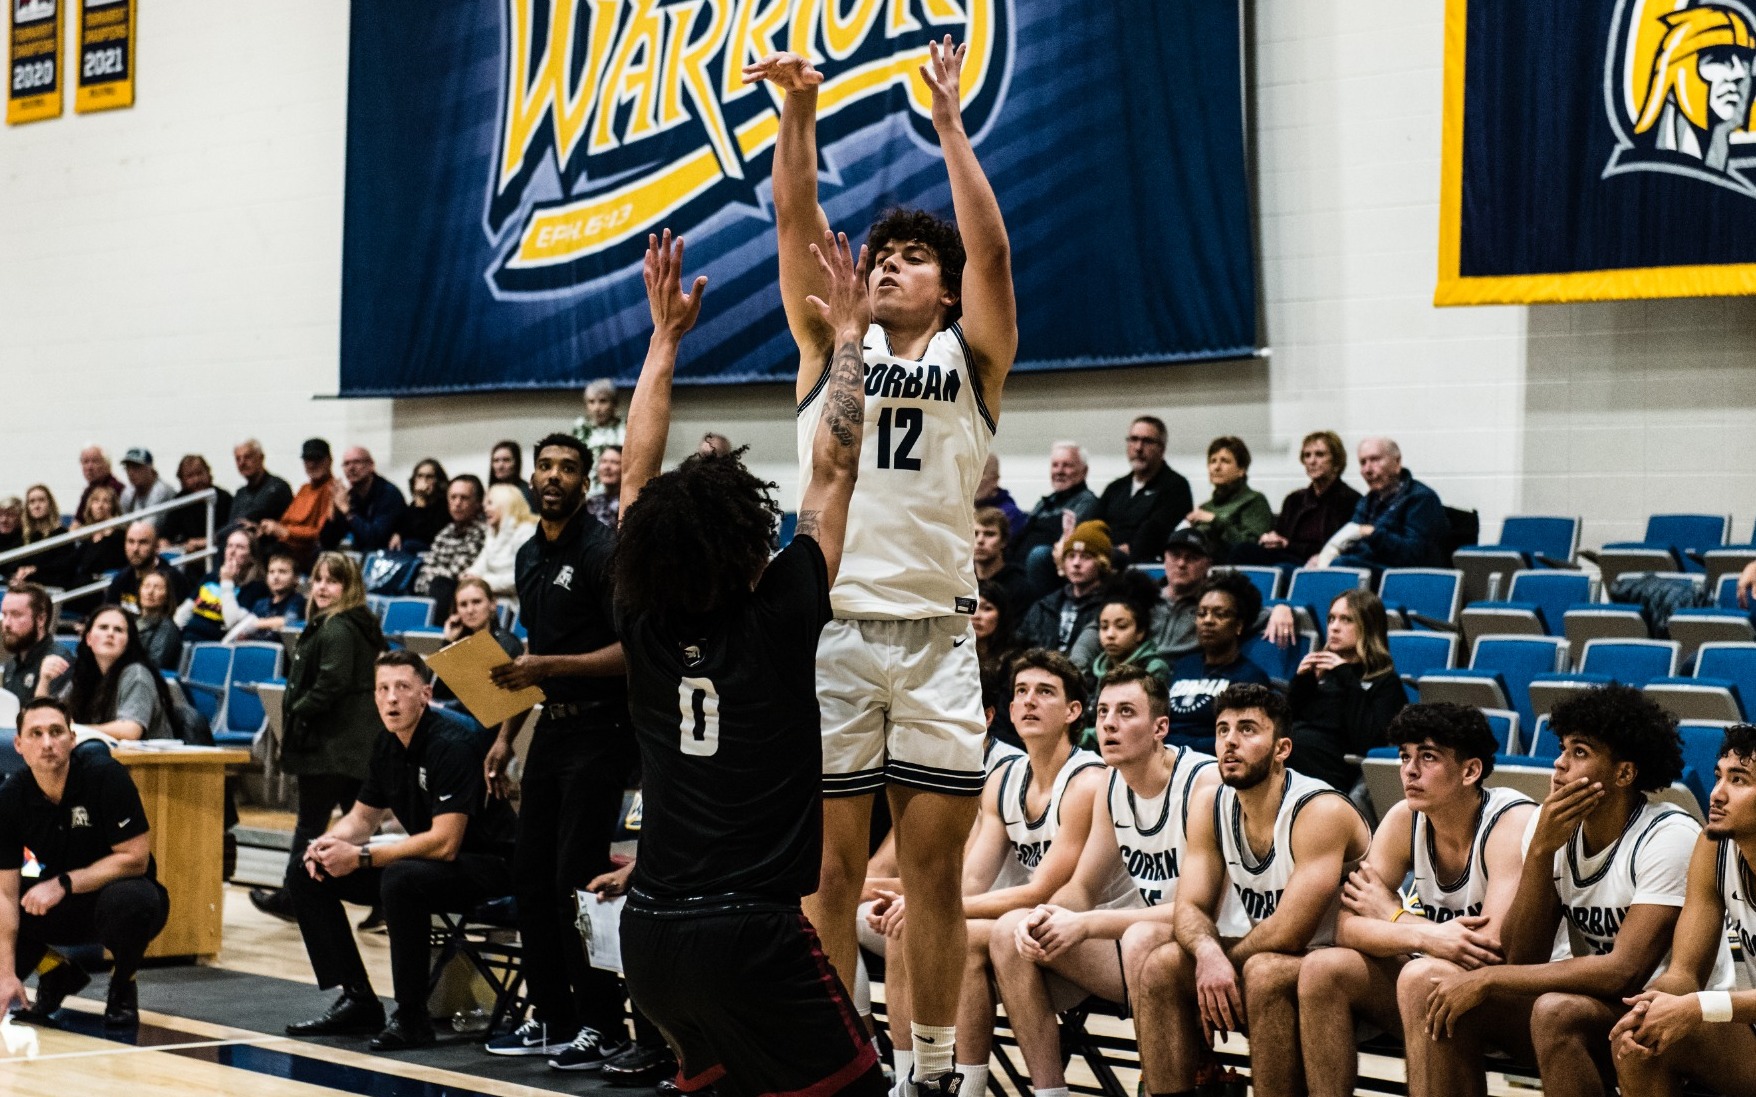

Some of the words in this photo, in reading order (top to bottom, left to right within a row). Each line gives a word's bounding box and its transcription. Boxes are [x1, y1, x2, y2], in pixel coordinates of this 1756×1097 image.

[12, 59, 54, 91] 2020
[83, 46, 124, 78] 2021
[864, 363, 961, 403] ORBAN
[877, 407, 923, 471] 12
[678, 676, 720, 757] 0
